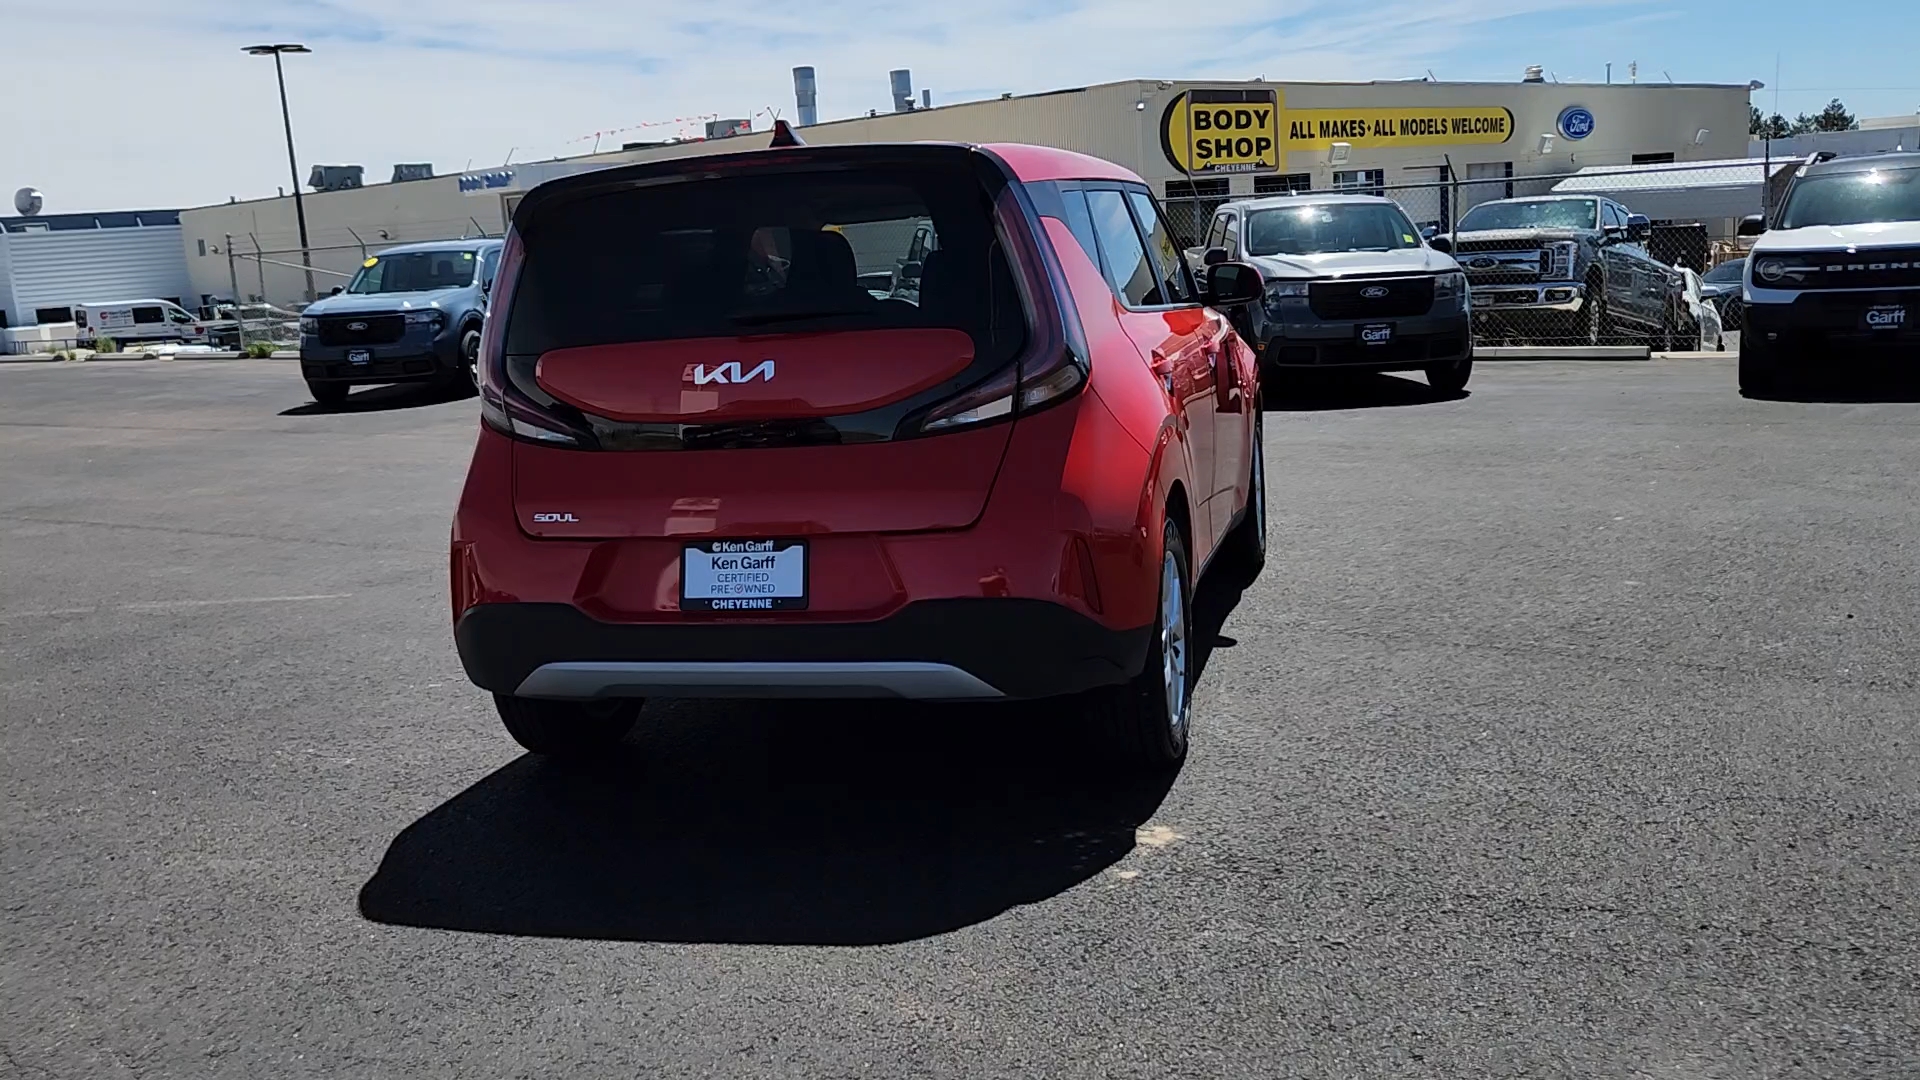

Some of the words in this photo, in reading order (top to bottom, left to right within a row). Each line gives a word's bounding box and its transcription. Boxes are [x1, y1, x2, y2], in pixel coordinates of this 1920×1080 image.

[1194, 109, 1271, 130] BODY
[1569, 114, 1591, 133] Ford
[1289, 120, 1316, 140] ALL
[1319, 119, 1366, 138] MAKES
[1373, 118, 1397, 137] ALL
[1400, 117, 1448, 136] MODELS
[1450, 117, 1505, 135] WELCOME
[1195, 137, 1272, 160] SHOP
[1214, 163, 1258, 173] CHEYENNE
[1866, 310, 1906, 324] Garff
[1361, 328, 1391, 340] Garff
[694, 360, 775, 385] KIA
[533, 513, 580, 522] SOUL
[722, 541, 744, 552] Ken
[745, 540, 774, 552] Garff
[711, 556, 738, 570] Ken
[740, 555, 776, 569] Garff
[717, 572, 769, 583] CERTIFIED
[711, 598, 773, 610] CHEYENNE
